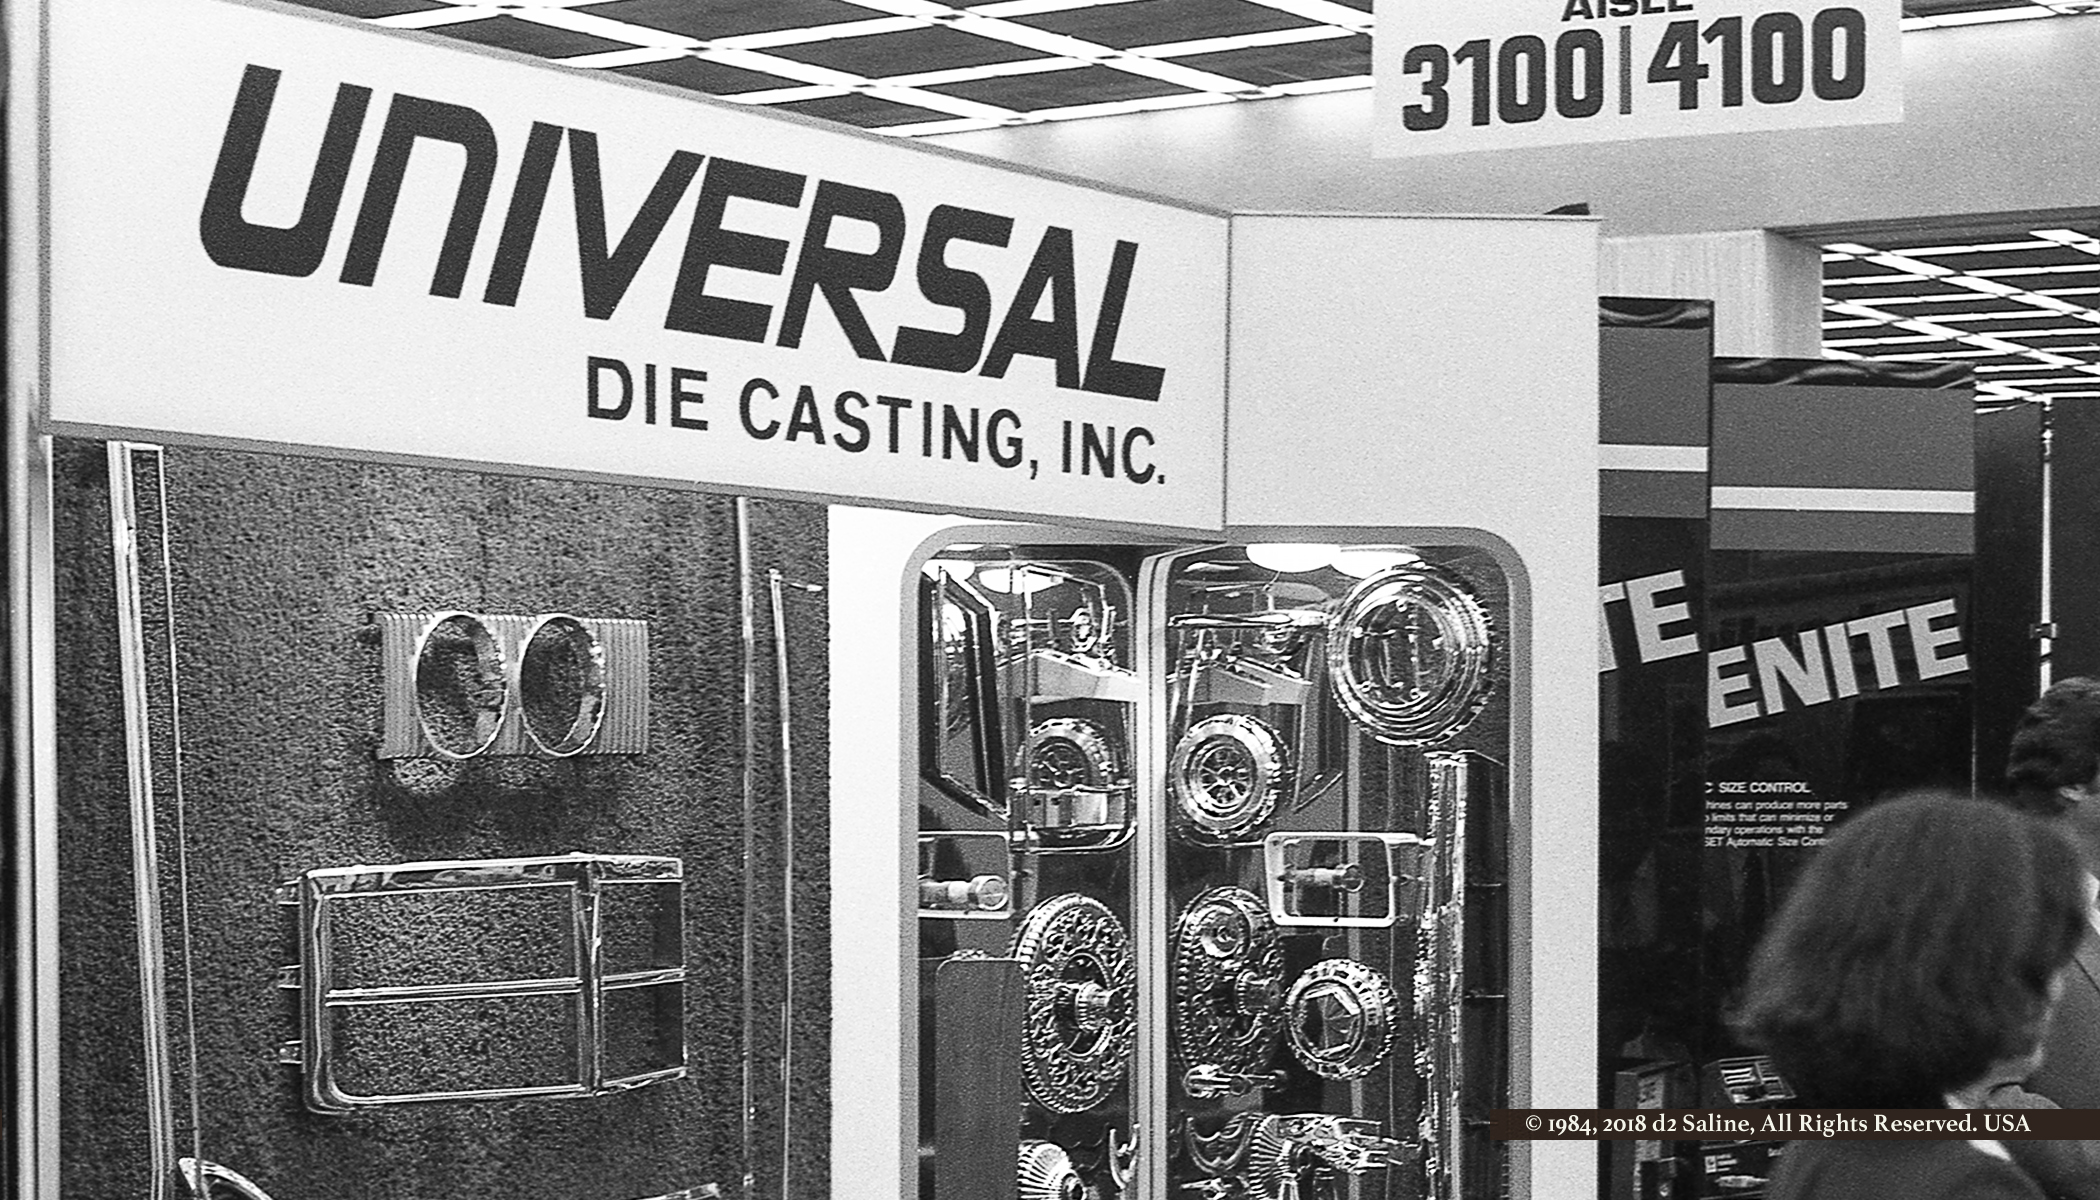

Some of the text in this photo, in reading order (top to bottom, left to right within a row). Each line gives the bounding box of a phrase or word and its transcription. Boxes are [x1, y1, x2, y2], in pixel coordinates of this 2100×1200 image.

[1402, 7, 1866, 132] 3100 4100
[199, 63, 1166, 402] UNIVERSAL
[587, 355, 1166, 485] DIE CASTING, INC.
[1707, 598, 1970, 729] ENITE
[1718, 781, 1748, 794] SIZE
[1749, 781, 1812, 794] CONTROL
[1734, 801, 1754, 810] can
[1755, 800, 1794, 812] produce
[1796, 801, 1822, 810] more
[1823, 800, 1849, 812] parts
[1711, 812, 1737, 822] limits
[1738, 813, 1757, 822] that
[1758, 814, 1778, 822] can
[1779, 812, 1821, 822] minimize
[1823, 814, 1835, 822] or
[1733, 826, 1784, 836] operations
[1786, 825, 1806, 835] with
[1807, 825, 1825, 835] the
[1725, 837, 1774, 849] Automatic
[1777, 836, 1800, 847] Size
